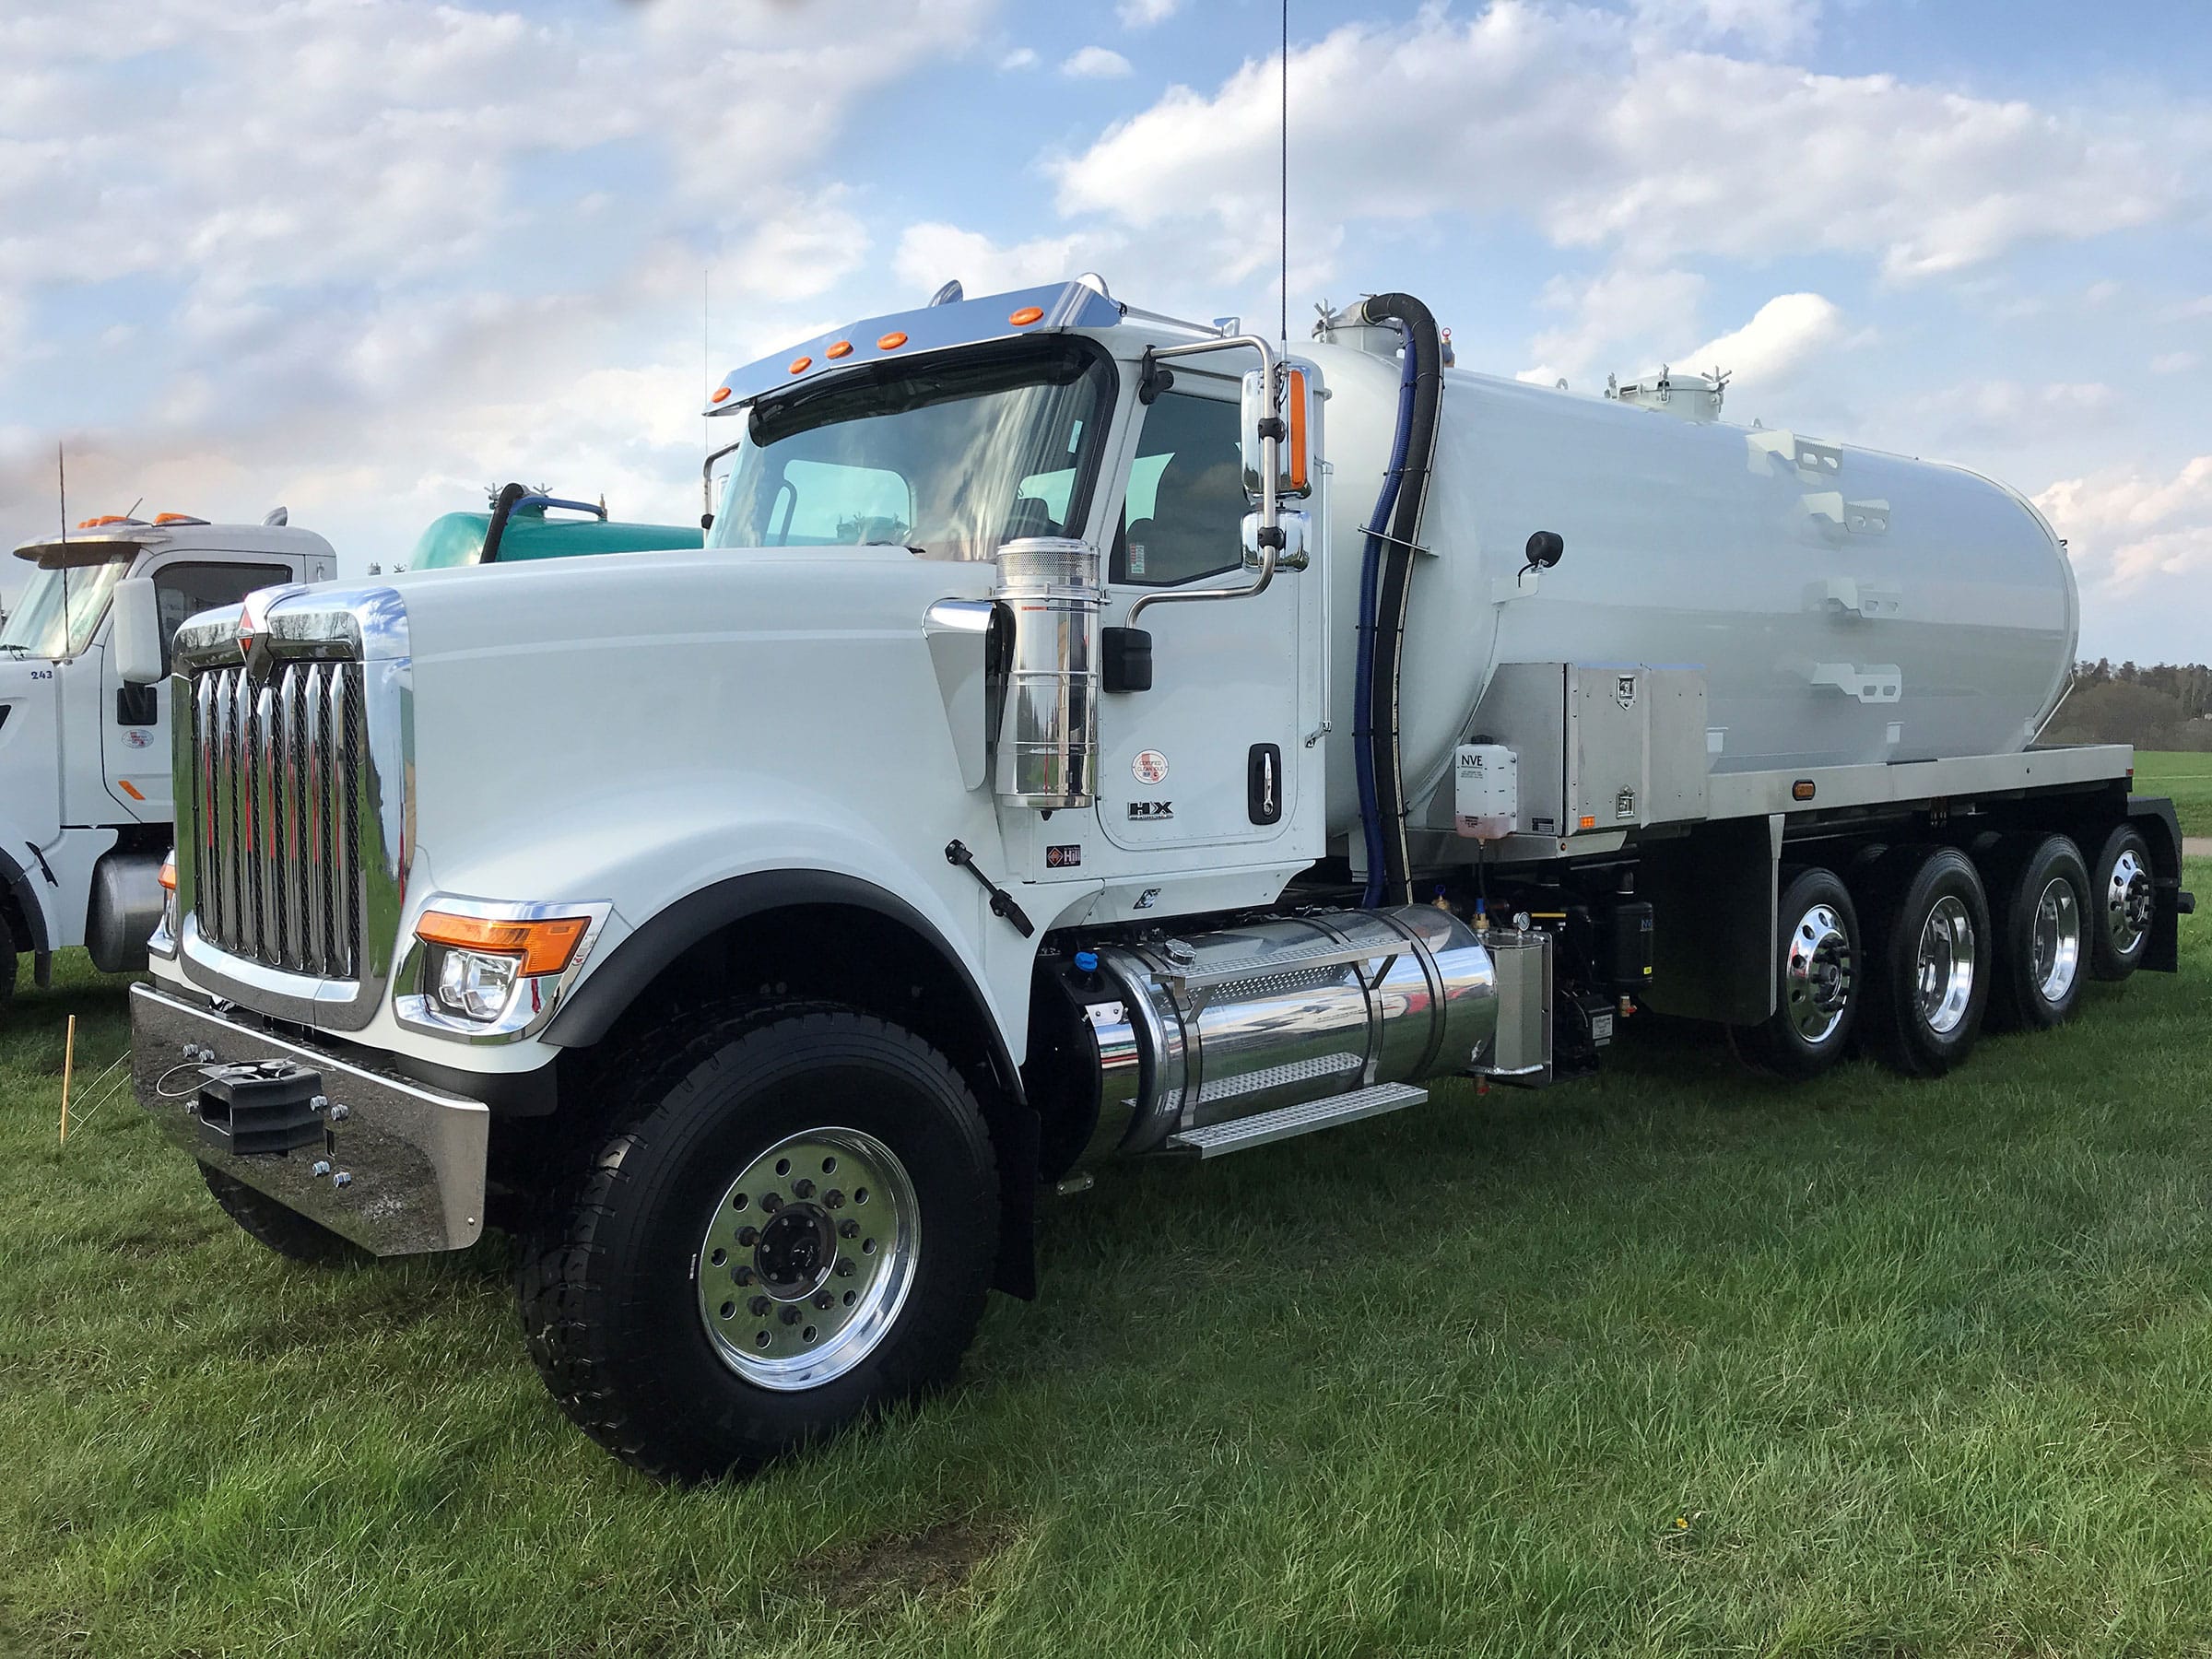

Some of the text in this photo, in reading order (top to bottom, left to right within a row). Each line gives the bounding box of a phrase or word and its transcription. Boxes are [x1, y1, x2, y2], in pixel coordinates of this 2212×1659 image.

[30, 670, 53, 680] 243
[1461, 755, 1483, 766] NVE
[1129, 801, 1174, 815] HX
